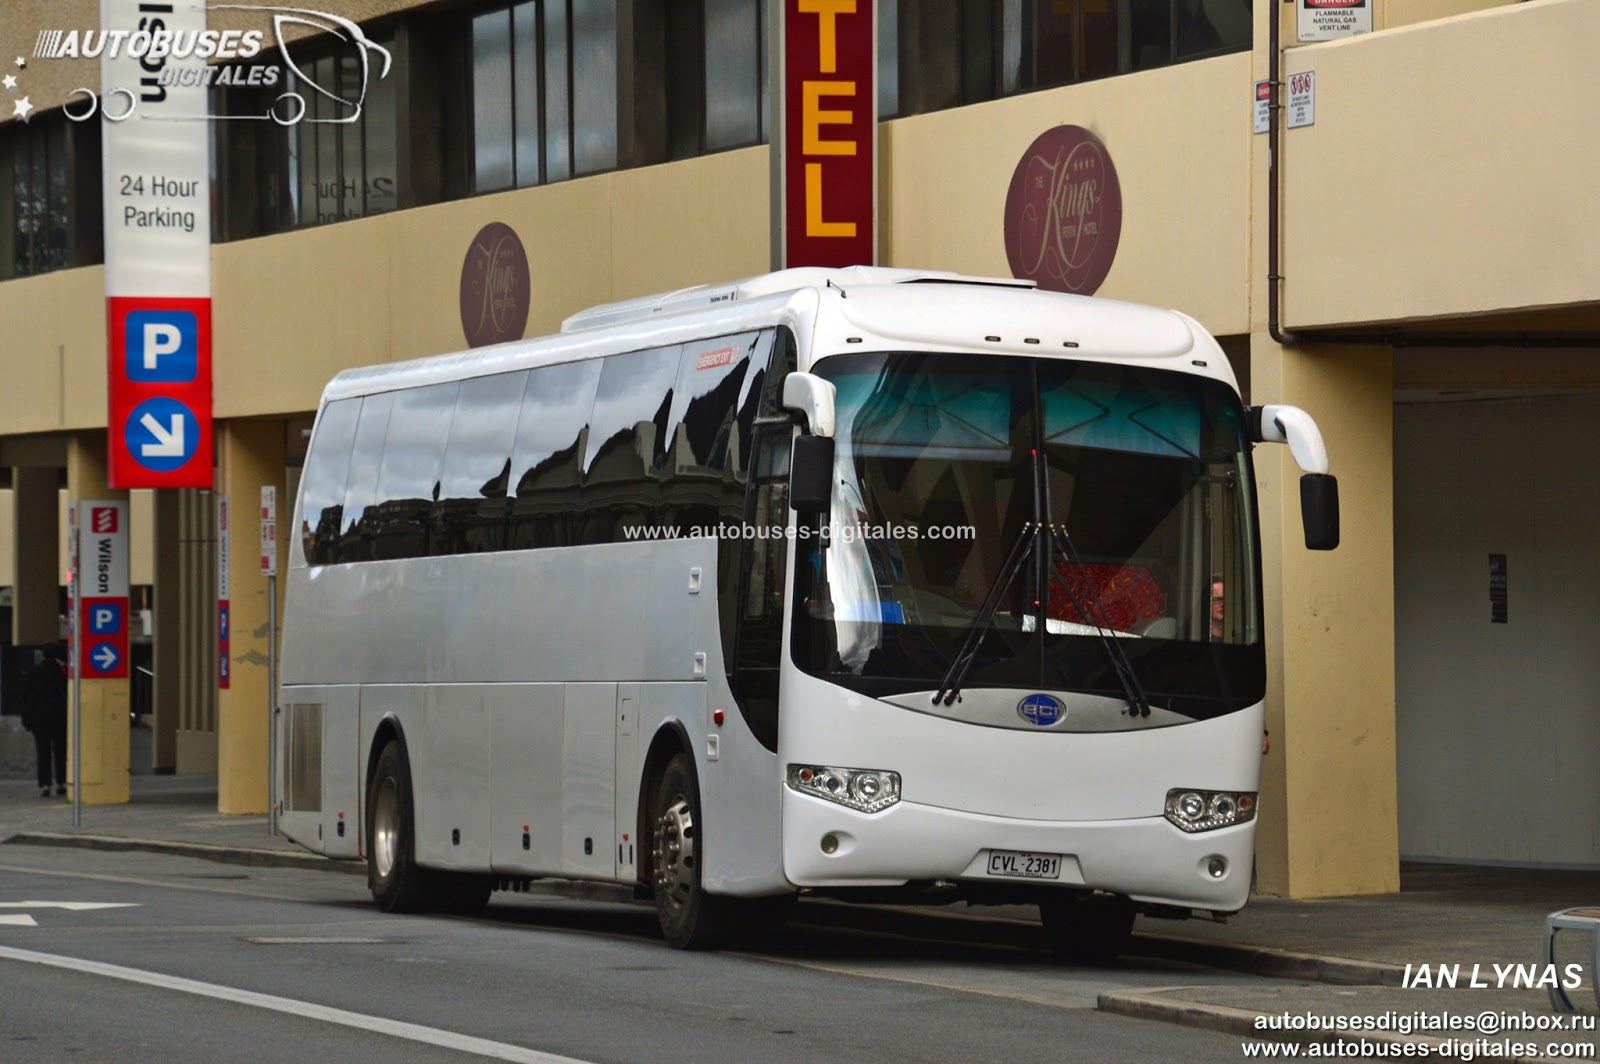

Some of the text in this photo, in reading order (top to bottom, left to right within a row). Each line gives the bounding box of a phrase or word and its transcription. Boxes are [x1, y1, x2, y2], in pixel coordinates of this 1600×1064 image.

[798, 0, 857, 237] TEL
[120, 175, 198, 197] 24 Hour
[1020, 141, 1104, 278] Kings
[124, 206, 195, 232] Parking
[143, 323, 182, 369] P
[98, 538, 111, 593] Wilson
